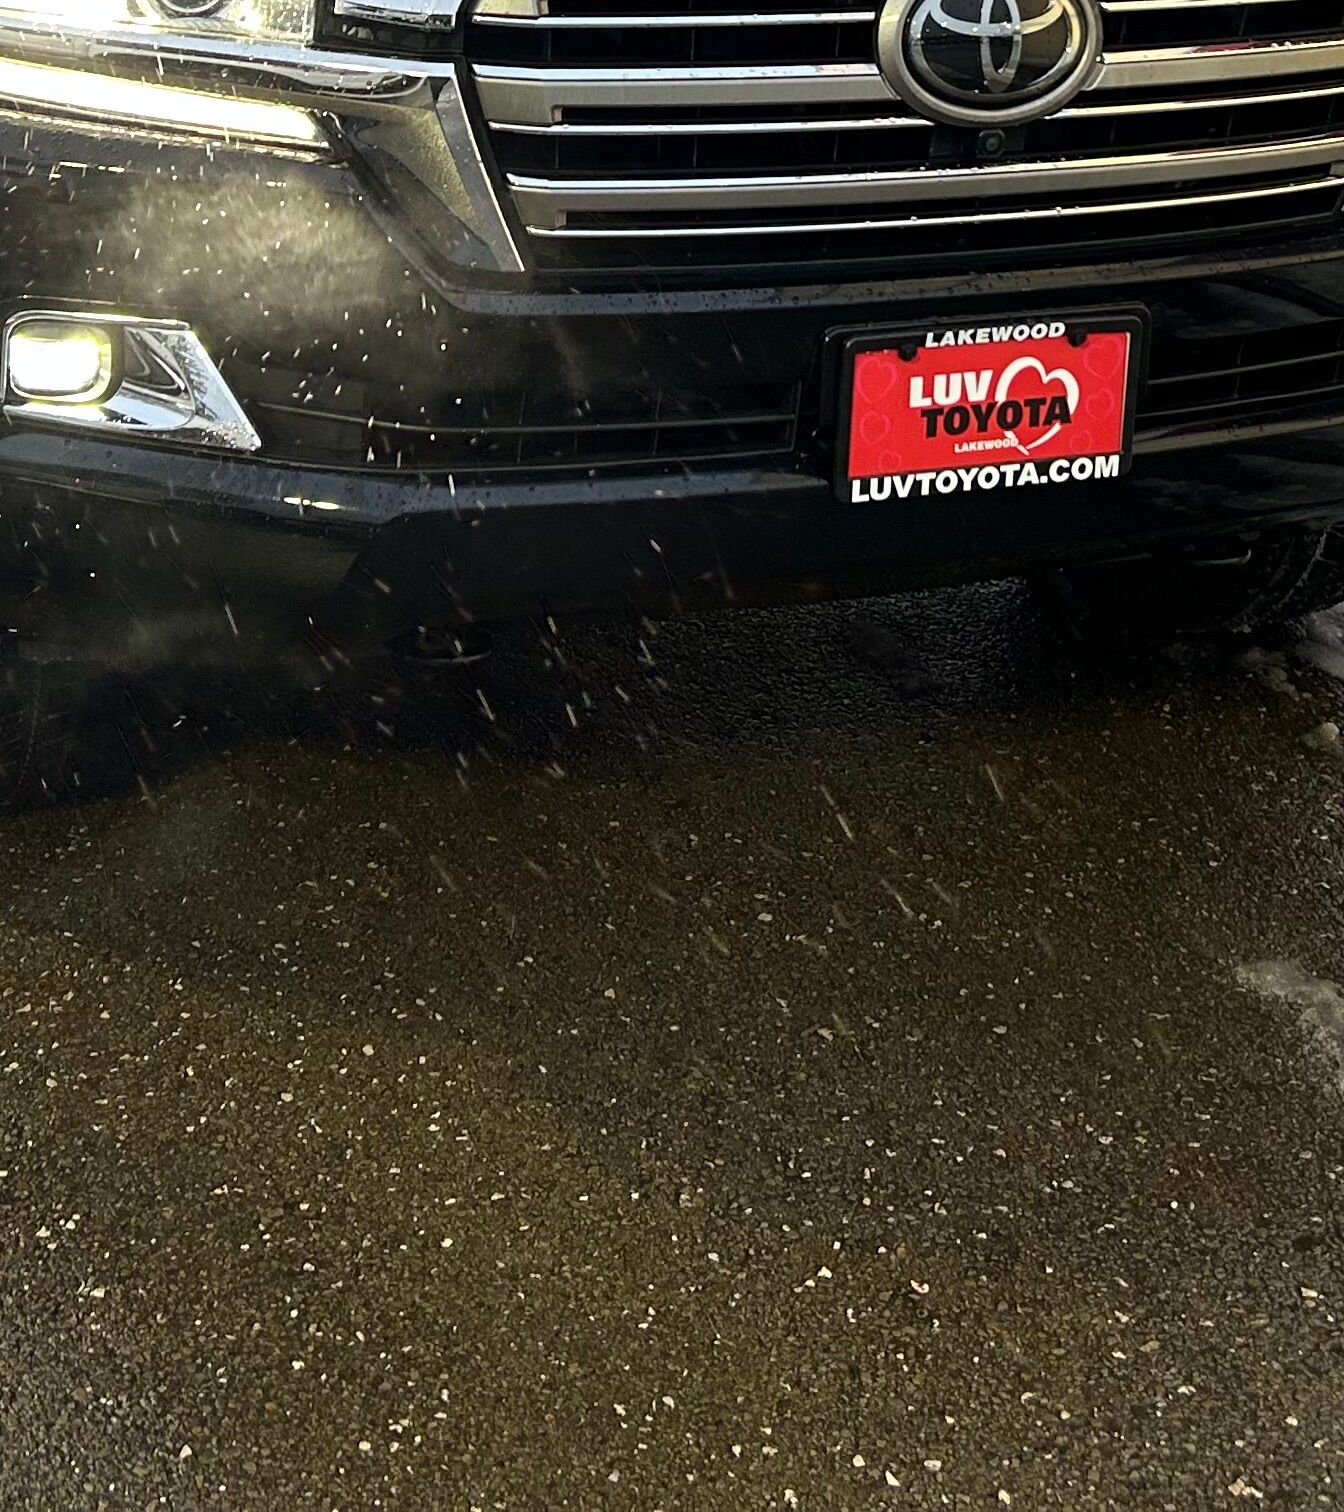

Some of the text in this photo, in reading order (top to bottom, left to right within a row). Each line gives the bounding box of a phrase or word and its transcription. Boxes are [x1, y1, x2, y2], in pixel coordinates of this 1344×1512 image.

[925, 321, 1066, 348] LAKEWOOD
[909, 369, 994, 409] LUV
[920, 395, 1072, 438] TOYOTA
[954, 437, 1019, 454] LAKEWOOD
[851, 454, 1120, 504] LUVTOYOTA.COM
